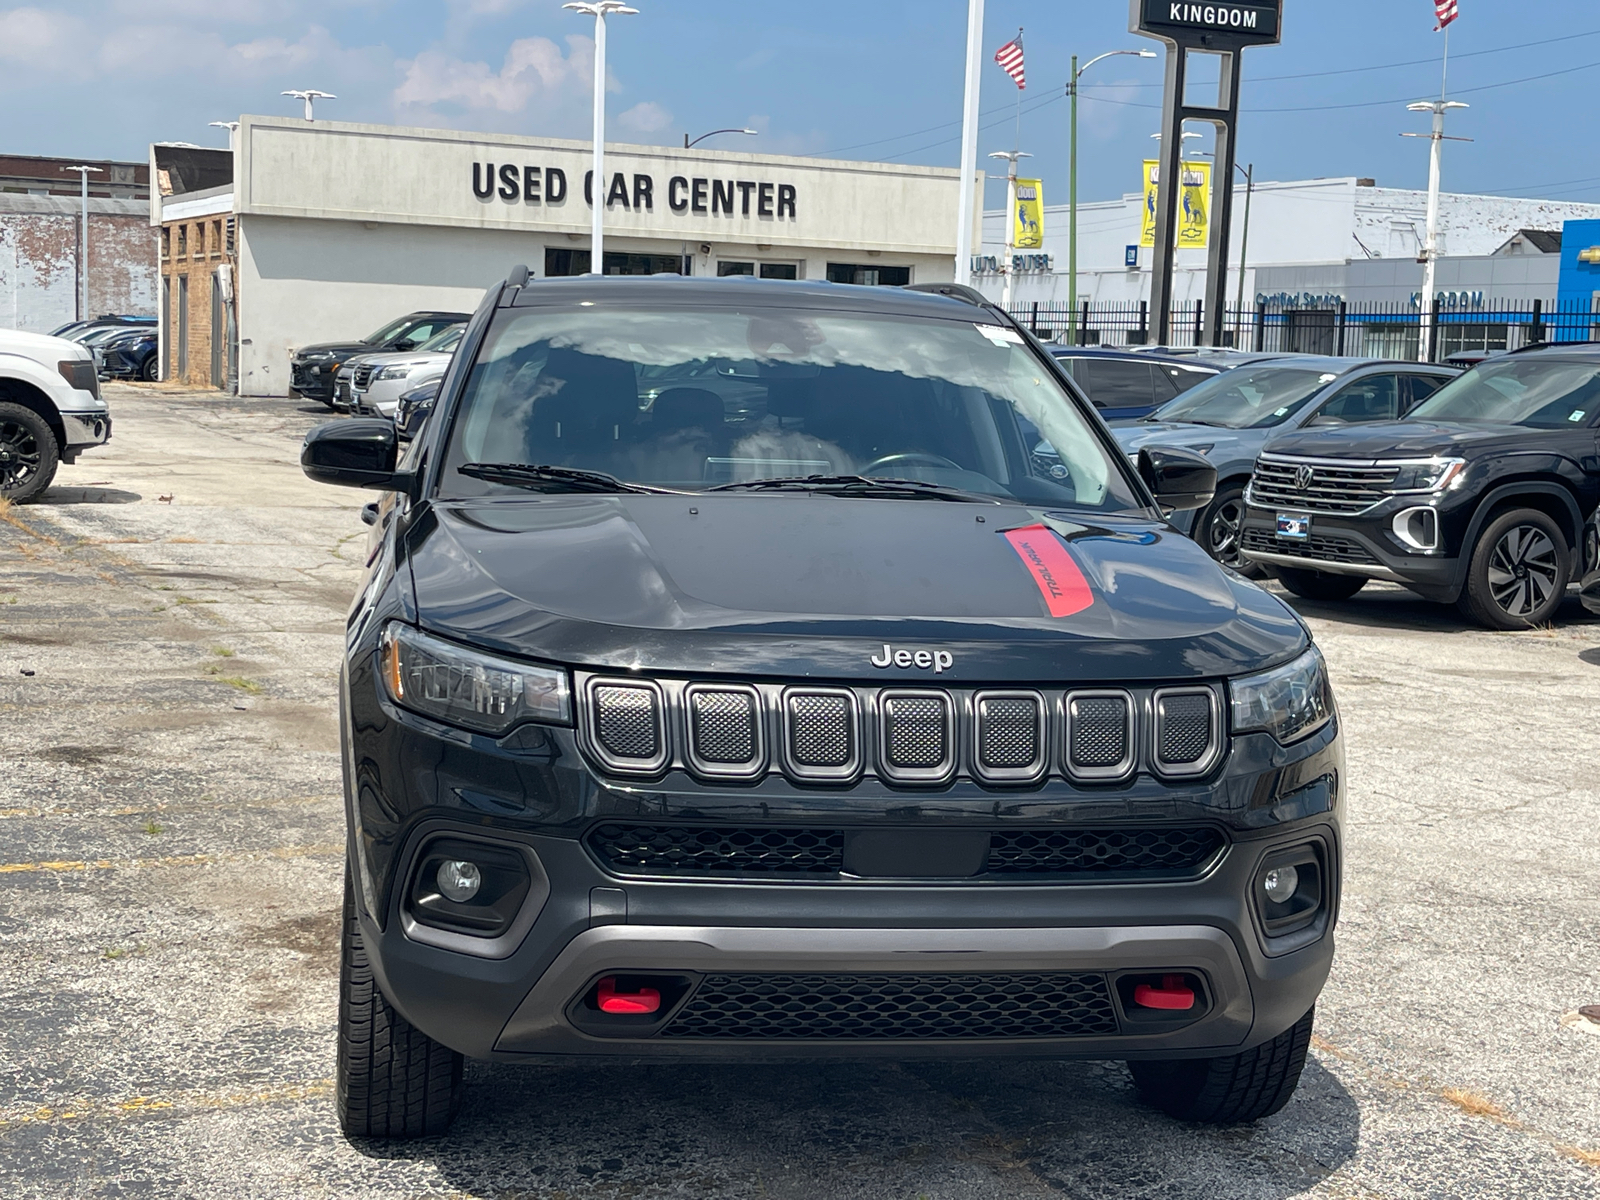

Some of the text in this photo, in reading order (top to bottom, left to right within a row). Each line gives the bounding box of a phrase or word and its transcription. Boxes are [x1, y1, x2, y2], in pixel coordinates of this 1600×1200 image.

[1170, 3, 1257, 28] KINGDOM
[472, 162, 566, 203] USED
[668, 175, 797, 218] CENTER
[1017, 185, 1036, 199] dom
[1012, 254, 1049, 270] ENTER
[1256, 292, 1342, 306] Certified Service
[1410, 291, 1483, 307] KGDOM
[870, 643, 954, 674] Jeep
